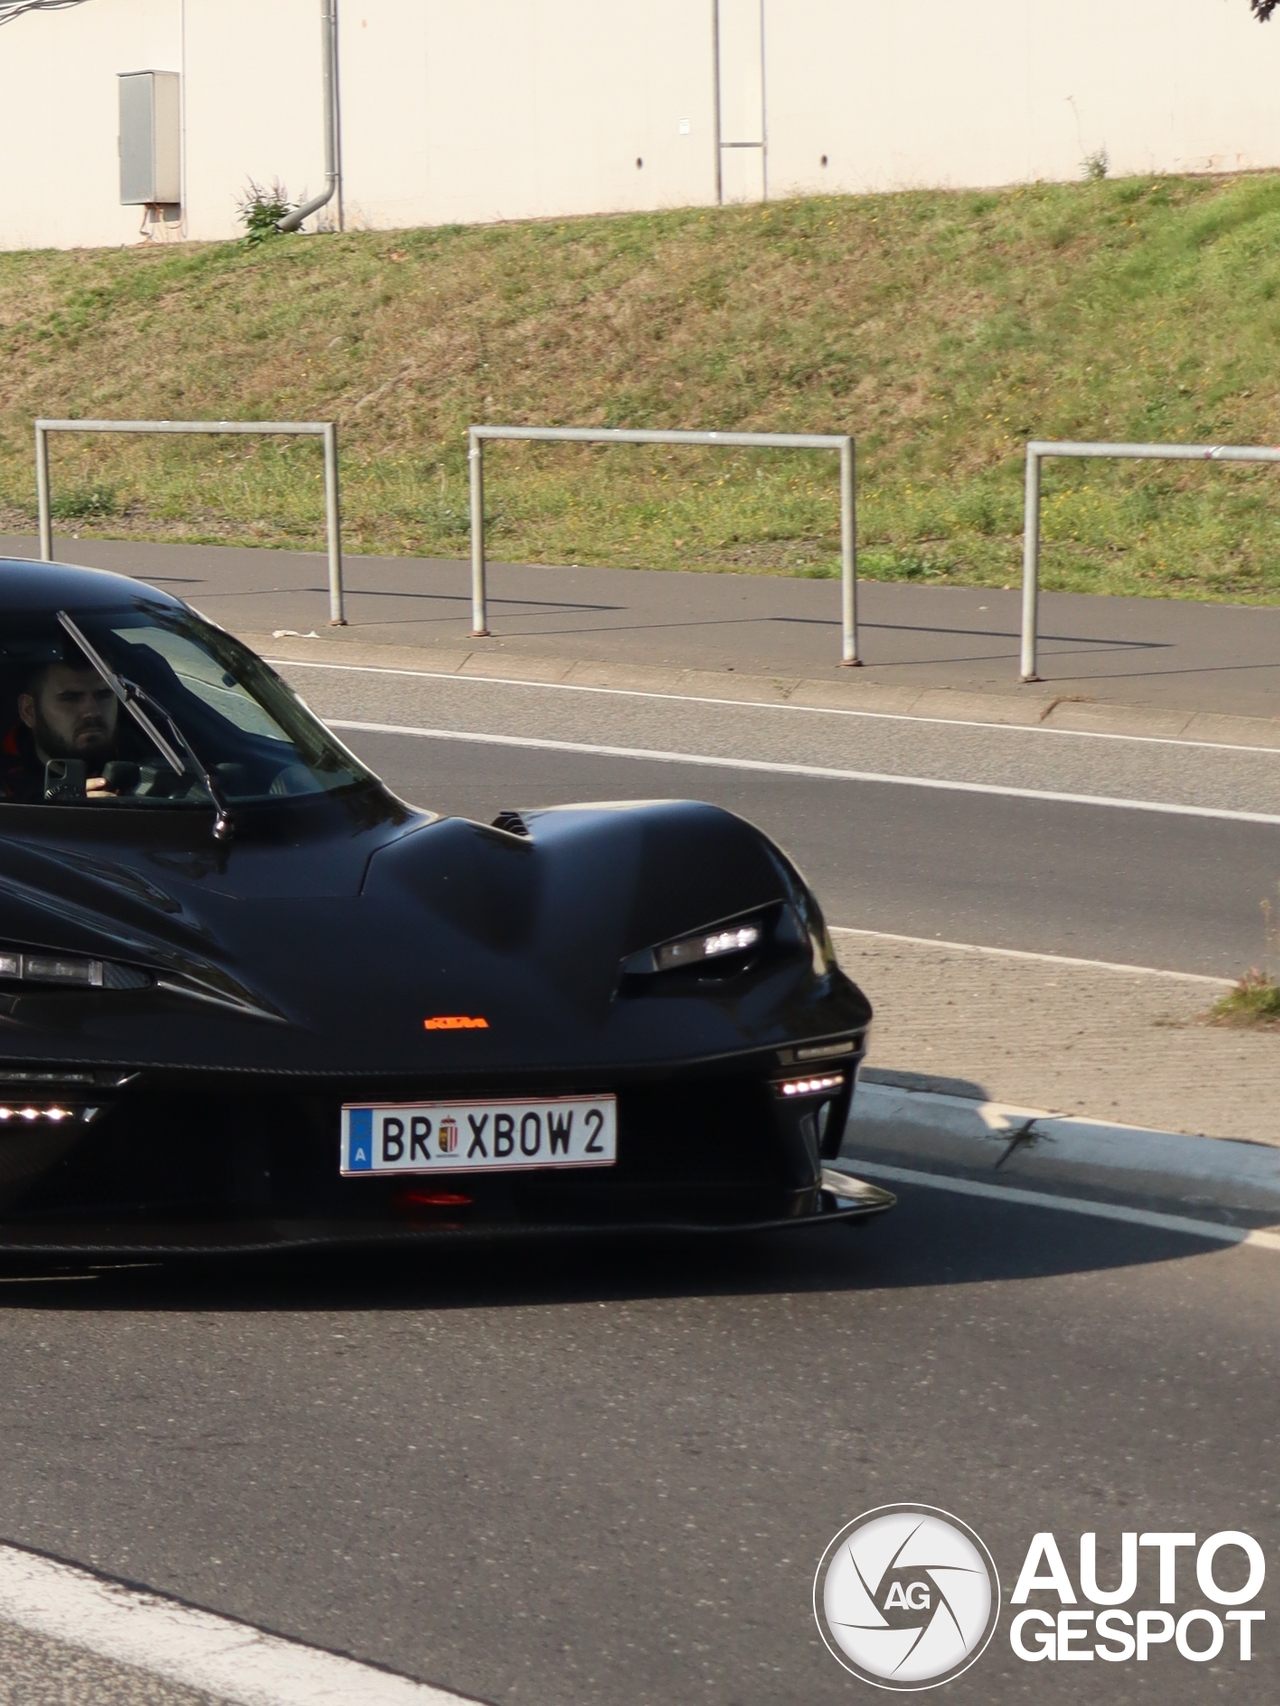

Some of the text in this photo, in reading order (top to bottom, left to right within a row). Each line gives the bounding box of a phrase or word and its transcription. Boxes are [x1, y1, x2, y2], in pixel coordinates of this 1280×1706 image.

[382, 1109, 604, 1162] BR XBOW 2
[354, 1148, 367, 1161] A
